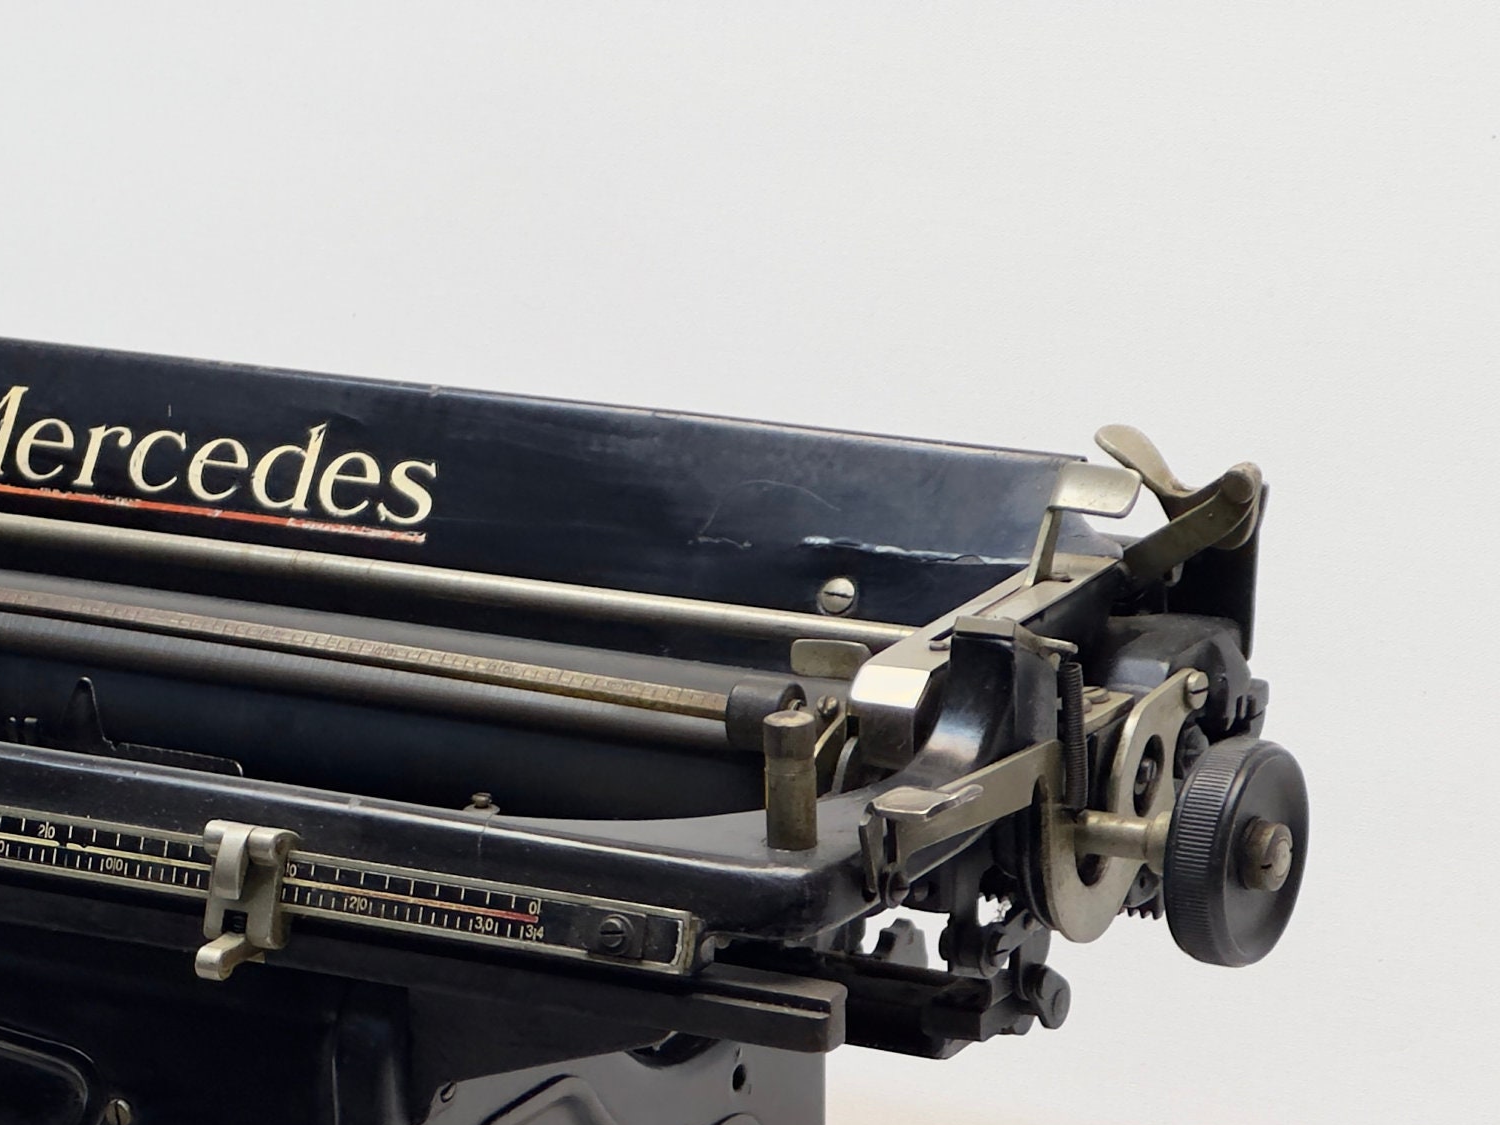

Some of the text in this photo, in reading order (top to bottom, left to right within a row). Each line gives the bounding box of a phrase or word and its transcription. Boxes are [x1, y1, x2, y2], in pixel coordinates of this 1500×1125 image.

[38, 822, 56, 839] 20
[349, 896, 368, 911] 20
[474, 916, 494, 931] 30
[525, 924, 545, 939] 34
